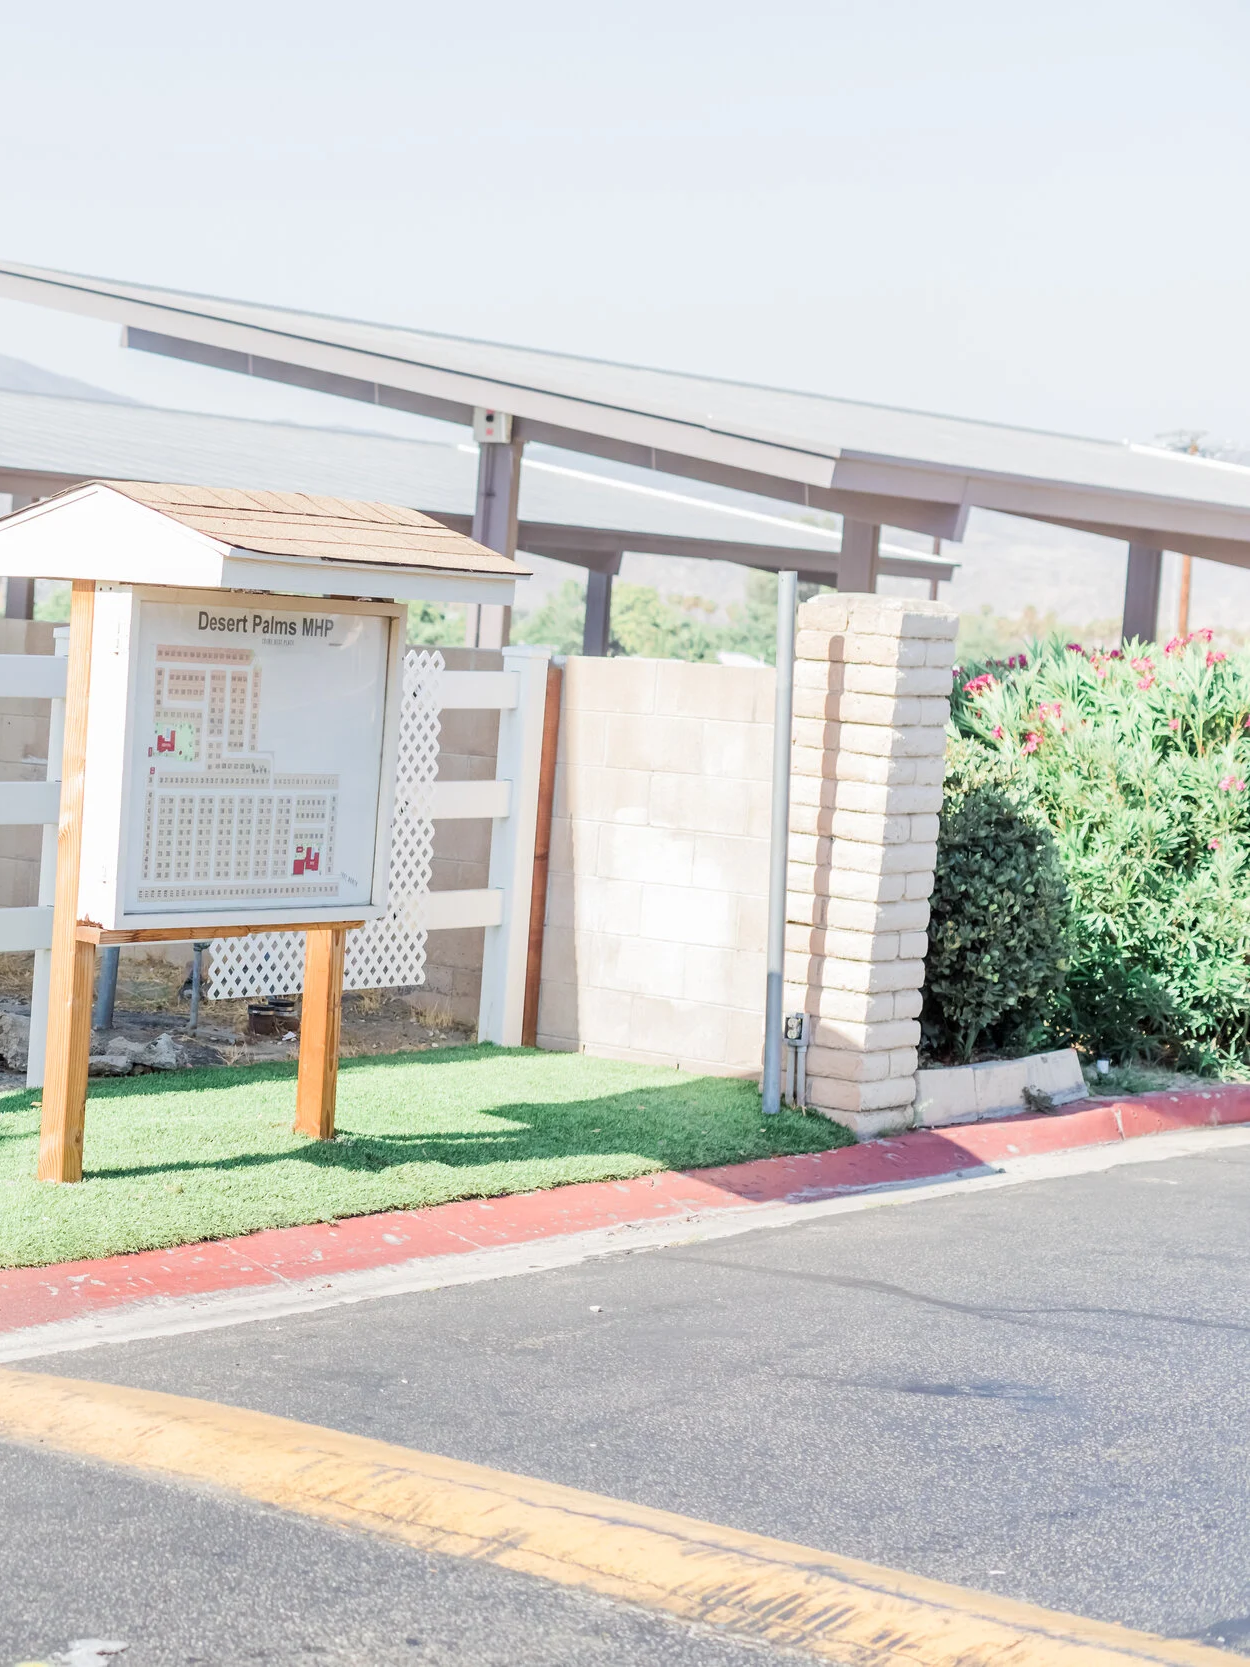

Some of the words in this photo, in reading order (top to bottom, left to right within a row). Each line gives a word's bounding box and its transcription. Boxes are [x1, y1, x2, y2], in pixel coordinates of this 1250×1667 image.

[198, 611, 248, 633] Desert
[252, 614, 297, 636] Palms
[302, 618, 335, 637] MHP
